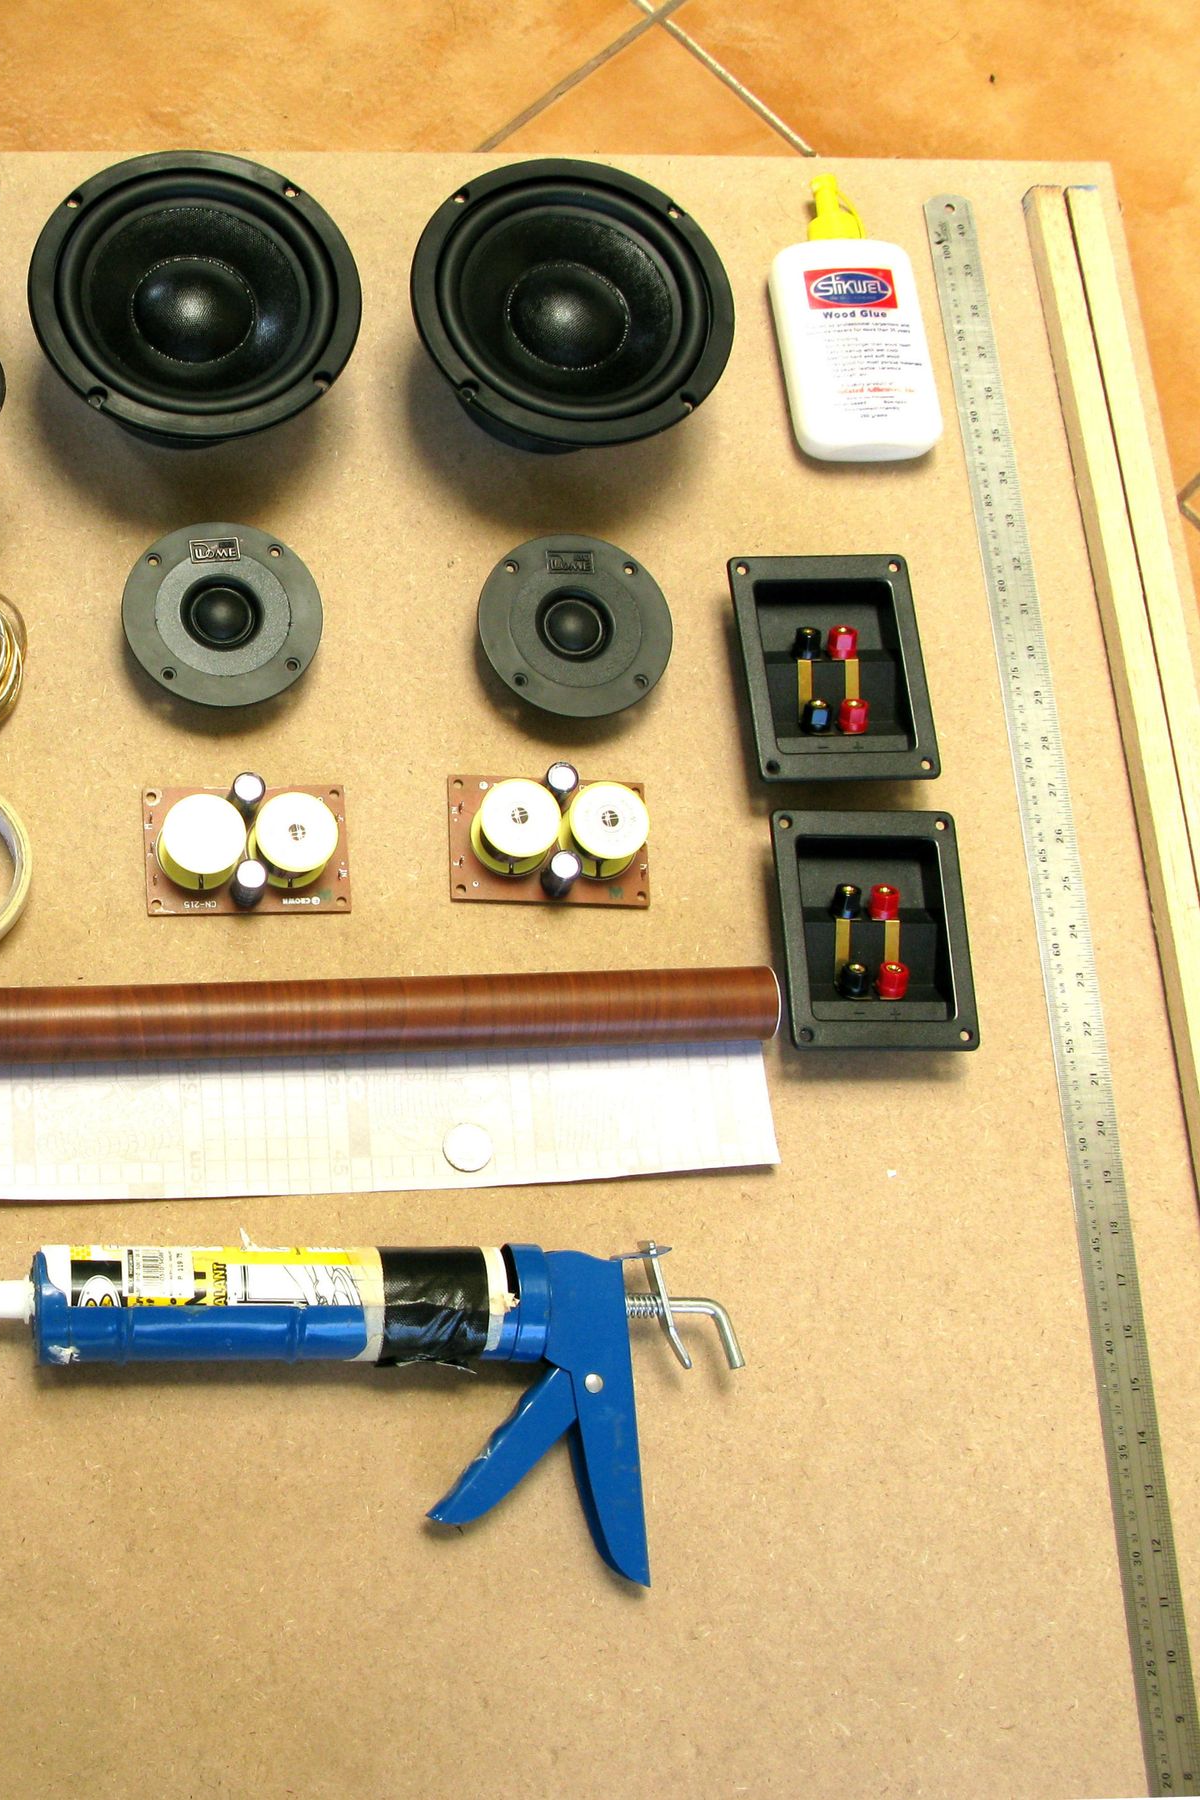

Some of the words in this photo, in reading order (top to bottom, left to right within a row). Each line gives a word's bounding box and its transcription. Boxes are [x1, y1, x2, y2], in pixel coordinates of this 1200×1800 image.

[823, 310, 857, 319] Wood
[860, 310, 888, 318] Glue
[1041, 736, 1050, 750] 28
[1025, 757, 1033, 769] 70
[1048, 782, 1057, 797] 27
[1055, 828, 1064, 843] 26
[1039, 848, 1047, 863] 65
[1062, 876, 1071, 891] 25
[1069, 924, 1078, 939] 24
[1052, 943, 1061, 956] 60
[1076, 972, 1085, 987] 23
[1083, 1021, 1092, 1036] 22
[1065, 1038, 1075, 1053] 55
[1090, 1072, 1099, 1086] 21
[1096, 1120, 1106, 1136] 20
[1079, 1137, 1088, 1152] 50
[1103, 1170, 1112, 1184] 19
[1110, 1220, 1119, 1235] 18
[1092, 1237, 1101, 1252] 45
[1116, 1273, 1126, 1286] 17
[1123, 1324, 1133, 1338] 16
[1105, 1340, 1114, 1355] 40
[1130, 1377, 1140, 1391] 15
[1137, 1430, 1147, 1444] 14
[1118, 1444, 1128, 1459] 35
[1144, 1484, 1154, 1498] 13
[1152, 1538, 1161, 1552] 12
[1132, 1551, 1142, 1566] 30
[1159, 1596, 1169, 1608] 11
[1167, 1650, 1177, 1664] 10
[1146, 1660, 1157, 1676] 25
[1175, 1715, 1185, 1724] 9
[1161, 1772, 1172, 1789] 20
[1184, 1772, 1193, 1781] 8
